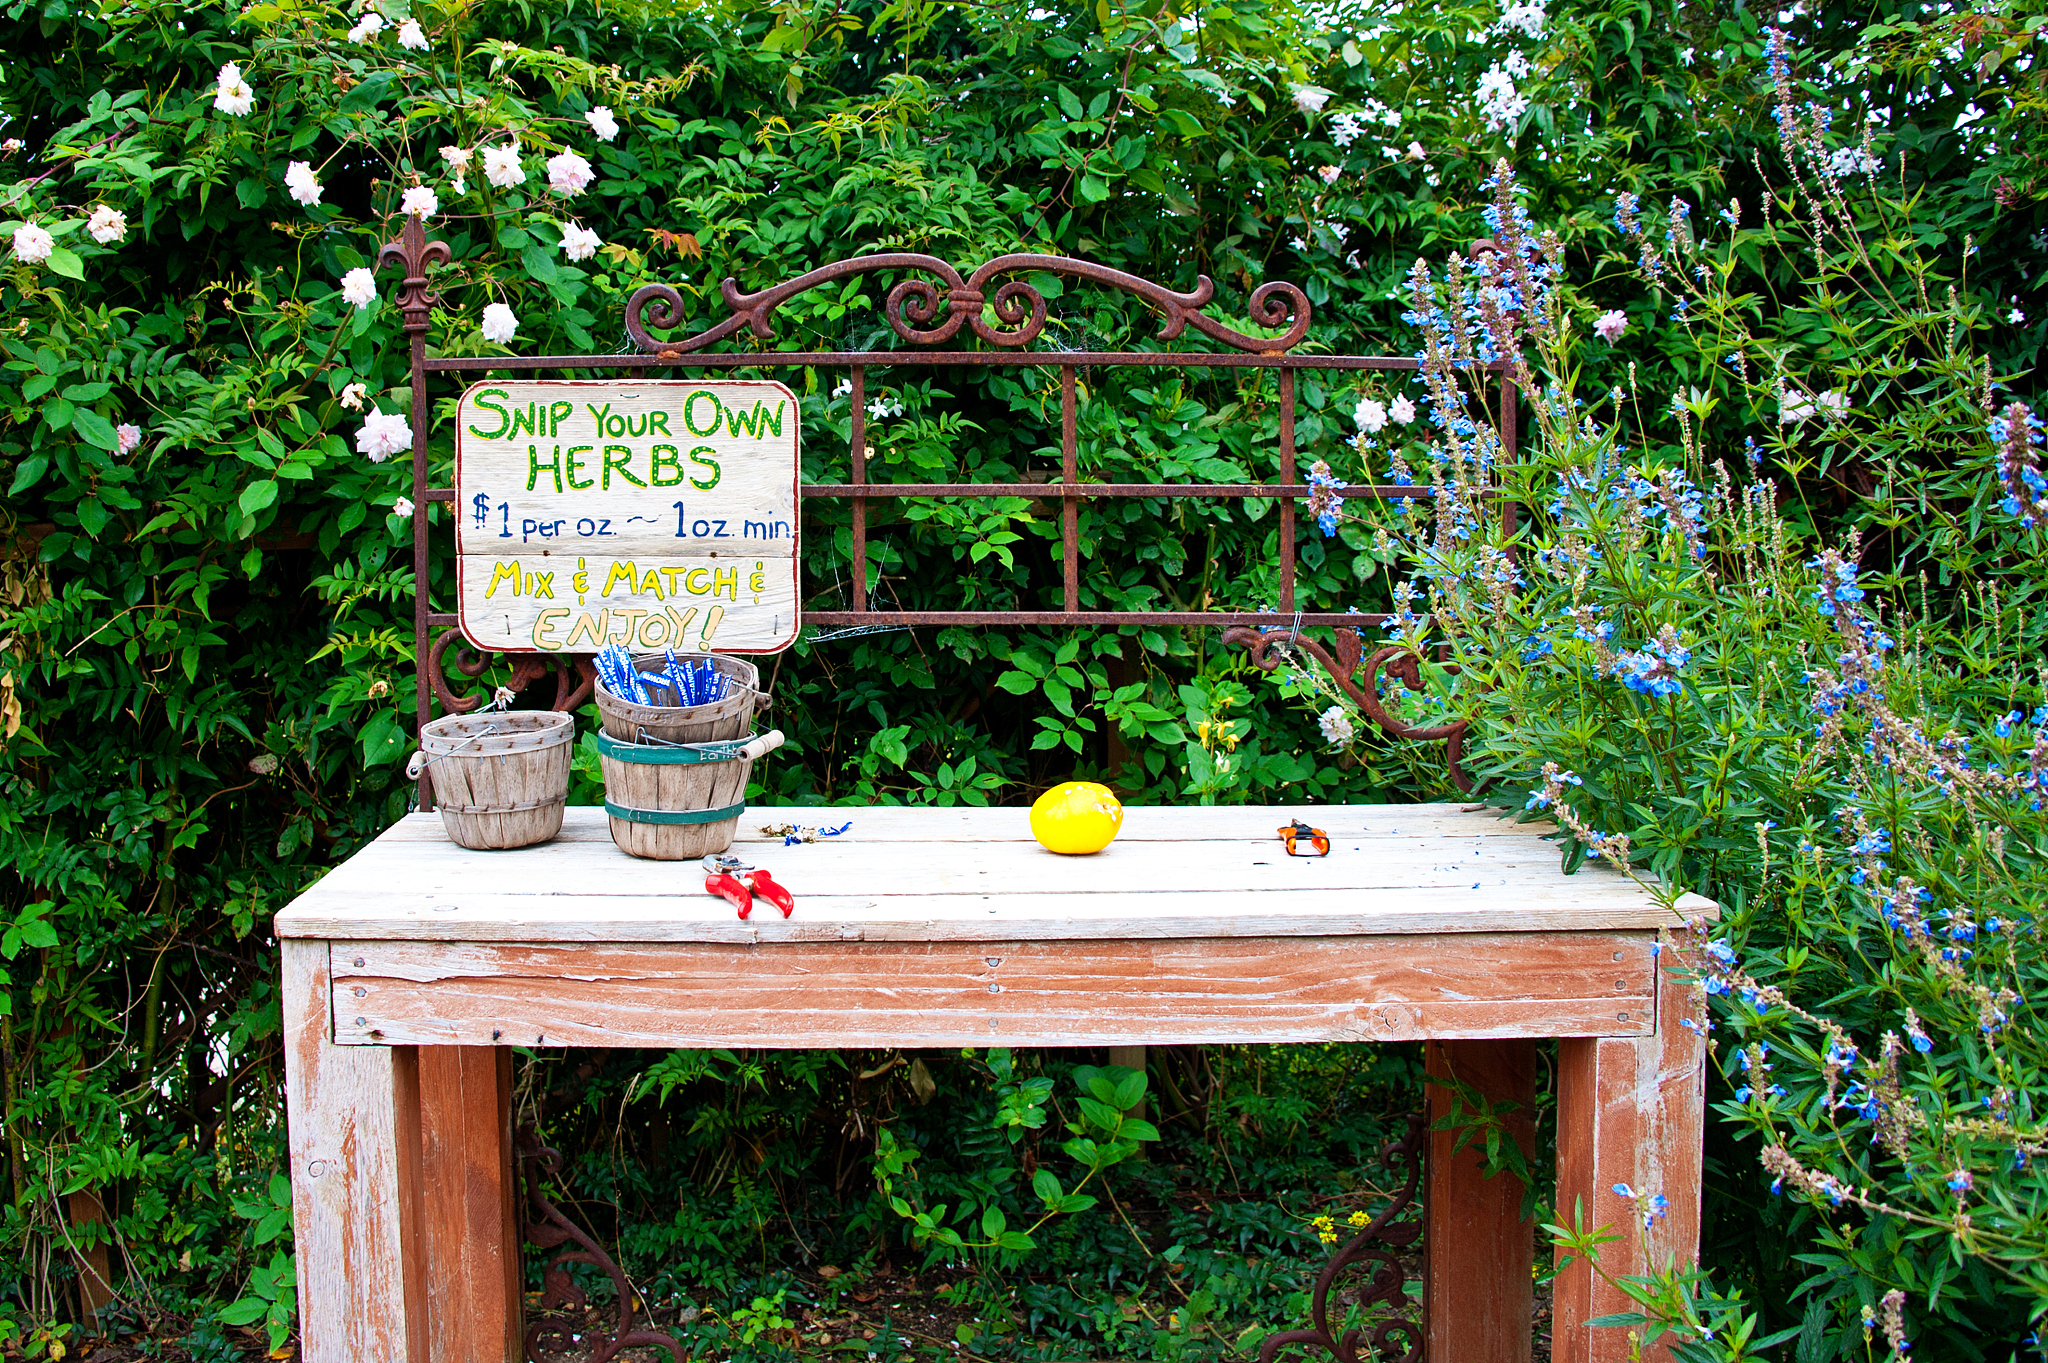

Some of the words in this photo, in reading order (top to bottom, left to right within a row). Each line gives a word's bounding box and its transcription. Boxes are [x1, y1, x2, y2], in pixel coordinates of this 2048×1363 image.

[468, 389, 573, 441] SNIP
[586, 402, 672, 439] YOUR
[683, 390, 786, 440] OWN
[527, 444, 722, 493] HERBS
[522, 518, 566, 543] per
[577, 518, 618, 537] oz.
[744, 510, 795, 540] min.
[485, 560, 555, 599] MIX
[601, 560, 738, 601] MATCH
[532, 606, 725, 651] ENJOY!
